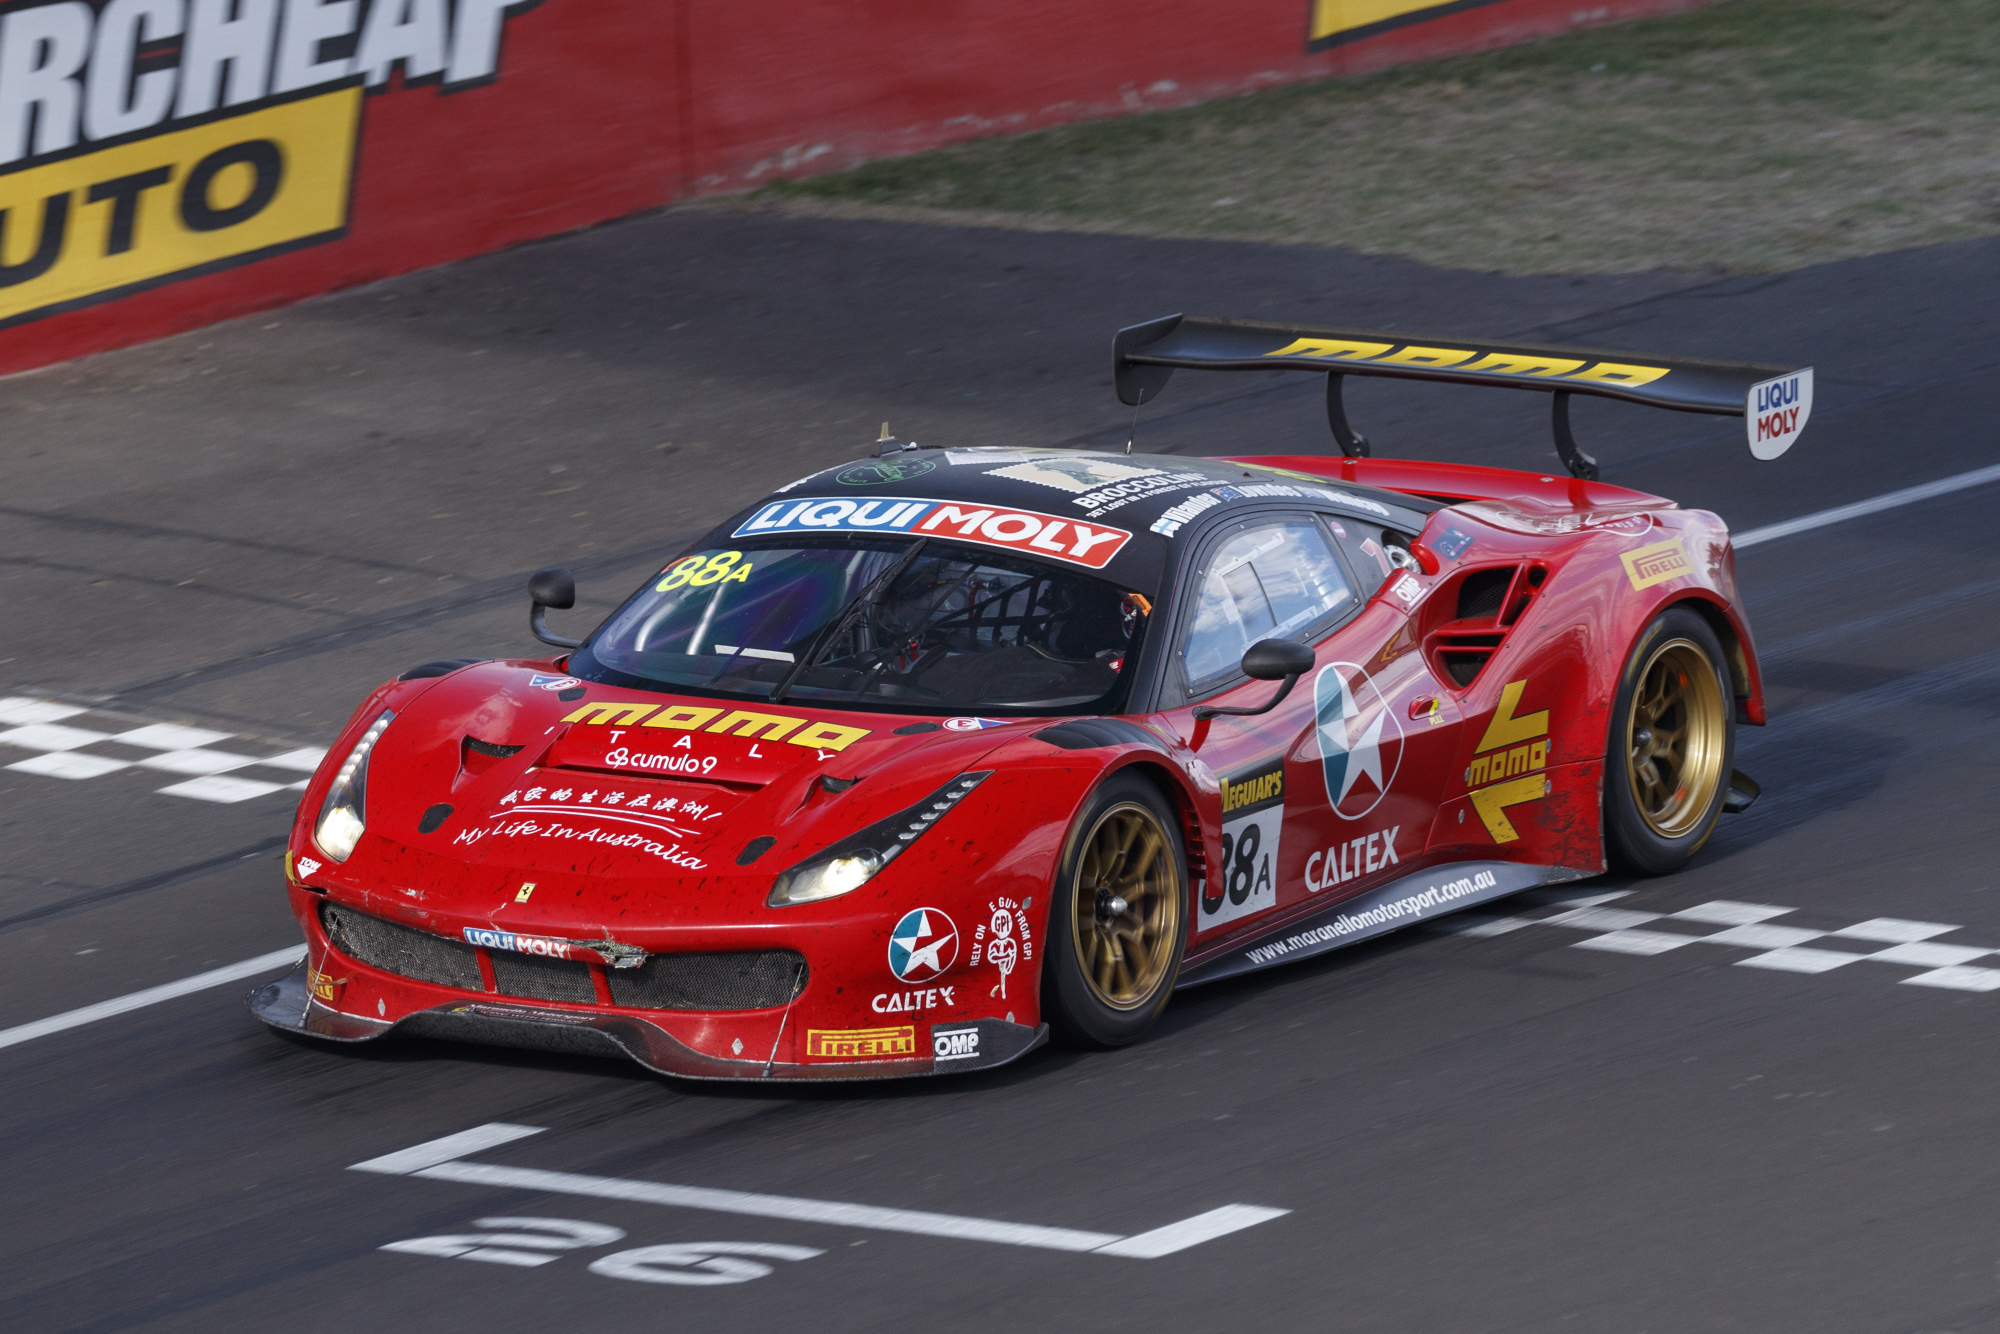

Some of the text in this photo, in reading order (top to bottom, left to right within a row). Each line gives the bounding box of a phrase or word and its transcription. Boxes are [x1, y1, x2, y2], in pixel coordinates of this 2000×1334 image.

[1757, 377, 1799, 412] LIQUI
[1757, 406, 1800, 442] MOLY
[745, 500, 1122, 558] LIQUI MOLY
[655, 550, 753, 592] 88A
[1631, 547, 1687, 580] PIRELLI
[1396, 577, 1422, 602] OMP
[453, 820, 707, 870] My Life In Australia
[1304, 824, 1401, 893] CALTEX
[300, 856, 322, 871] TOW
[994, 914, 1010, 933] GPI
[1015, 909, 1031, 940] FROM
[1245, 869, 1497, 964] www.maranellomotorsport.com.au
[465, 930, 568, 959] LIQUI MOLY
[975, 924, 986, 940] ON
[969, 943, 982, 967] RELY
[1023, 942, 1032, 960] GPI
[871, 986, 955, 1013] CALTEX
[809, 1028, 914, 1055] PIRELLI
[934, 1031, 979, 1057] OMP
